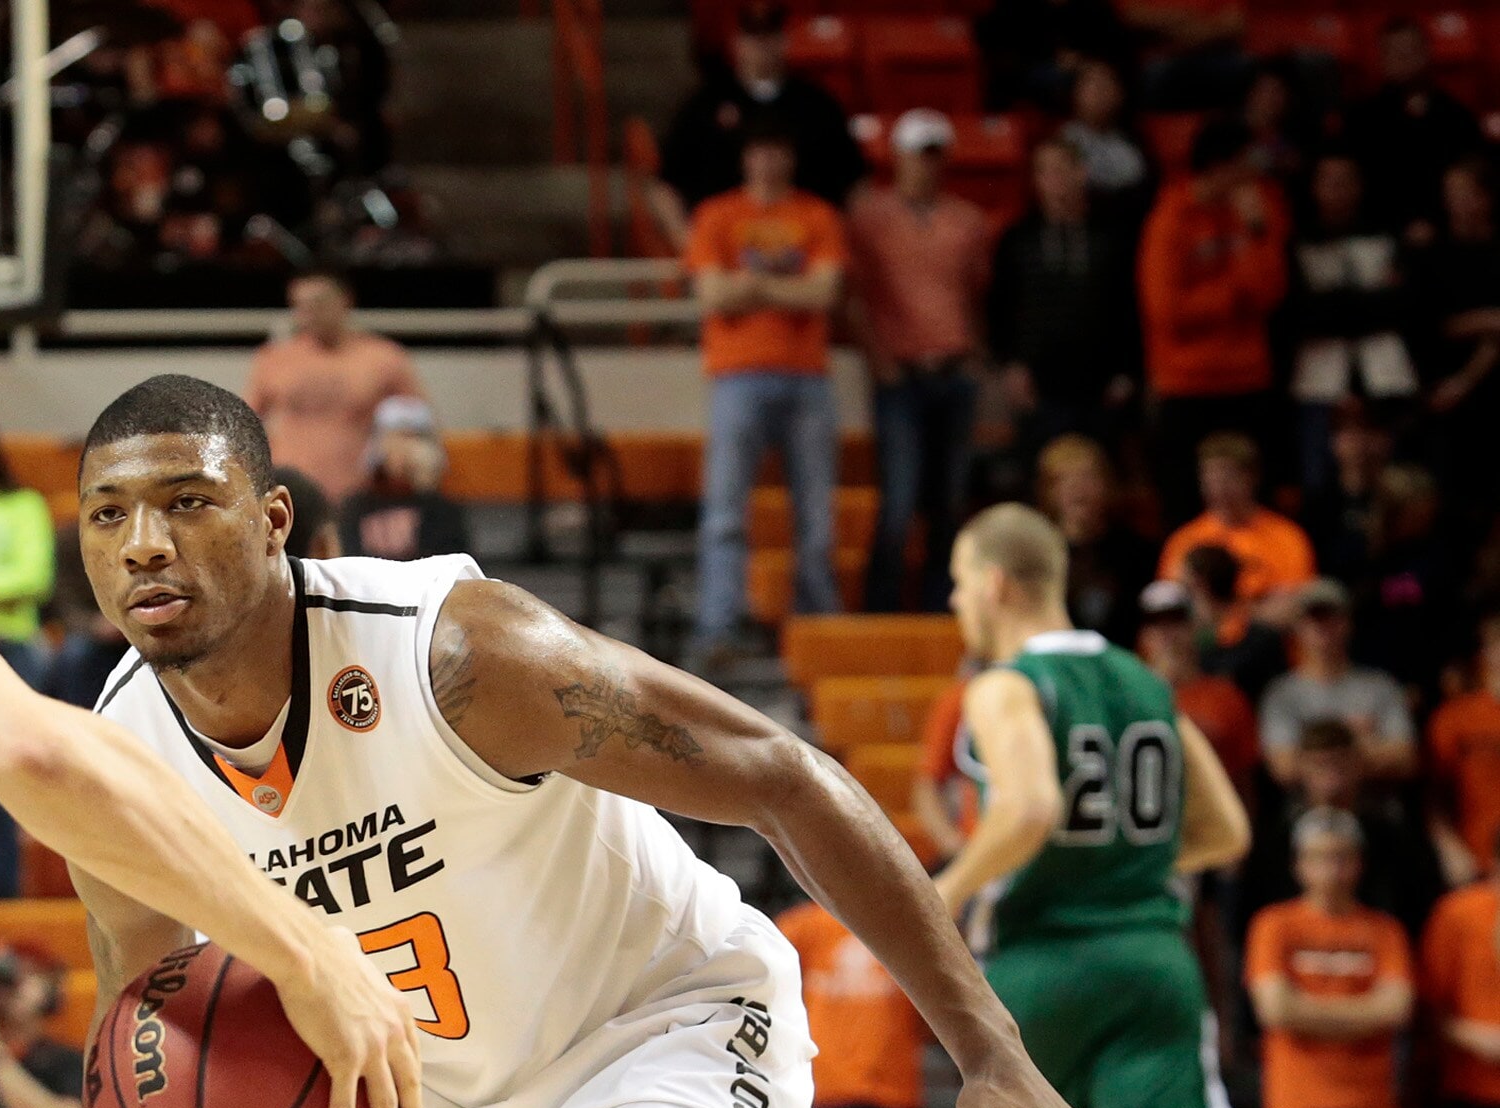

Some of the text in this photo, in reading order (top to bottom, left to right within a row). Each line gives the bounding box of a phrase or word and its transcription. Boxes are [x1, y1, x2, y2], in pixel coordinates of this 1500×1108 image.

[341, 683, 374, 716] 75
[1053, 720, 1182, 846] 20
[249, 804, 405, 873] LAHOMA
